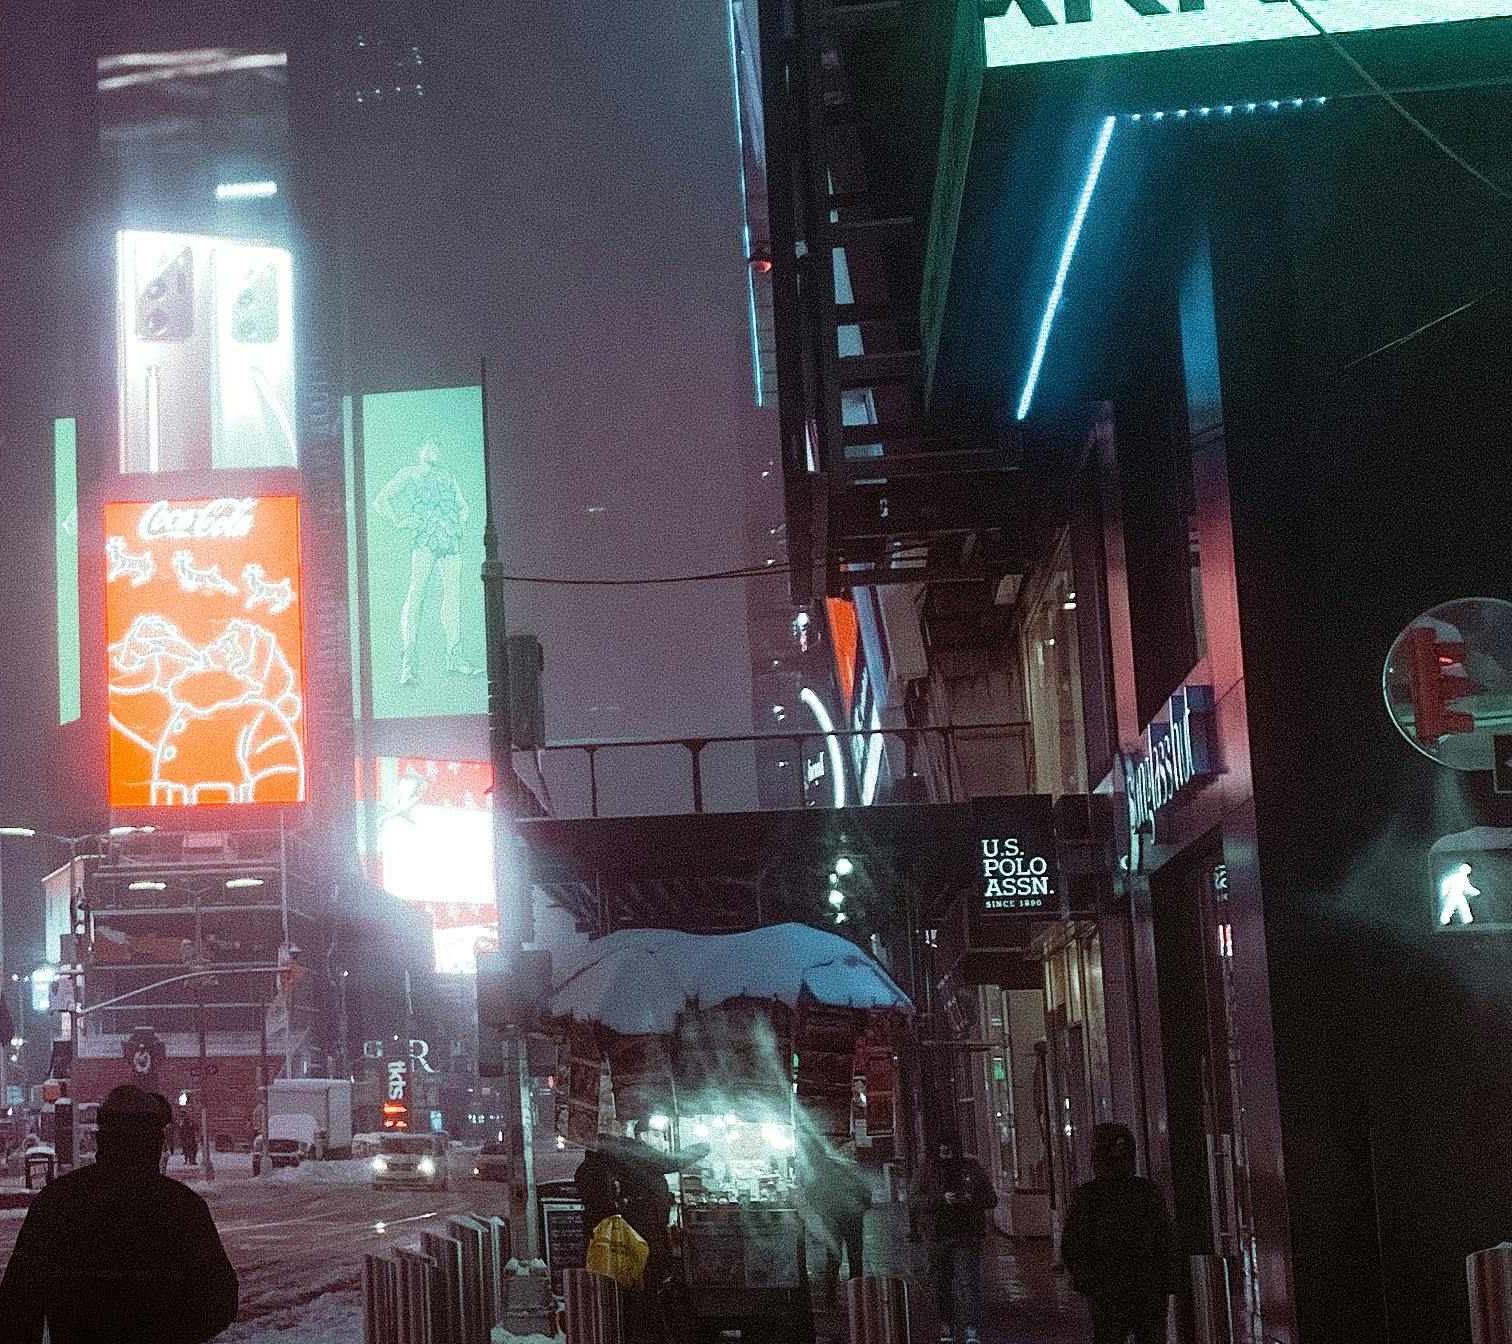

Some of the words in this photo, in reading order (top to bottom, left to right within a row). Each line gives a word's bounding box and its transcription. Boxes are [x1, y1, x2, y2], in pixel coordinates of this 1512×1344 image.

[981, 838, 1025, 857] U.S.
[983, 856, 1048, 877] POLO
[984, 876, 1055, 897] ASSN.
[985, 900, 1016, 909] SINCE
